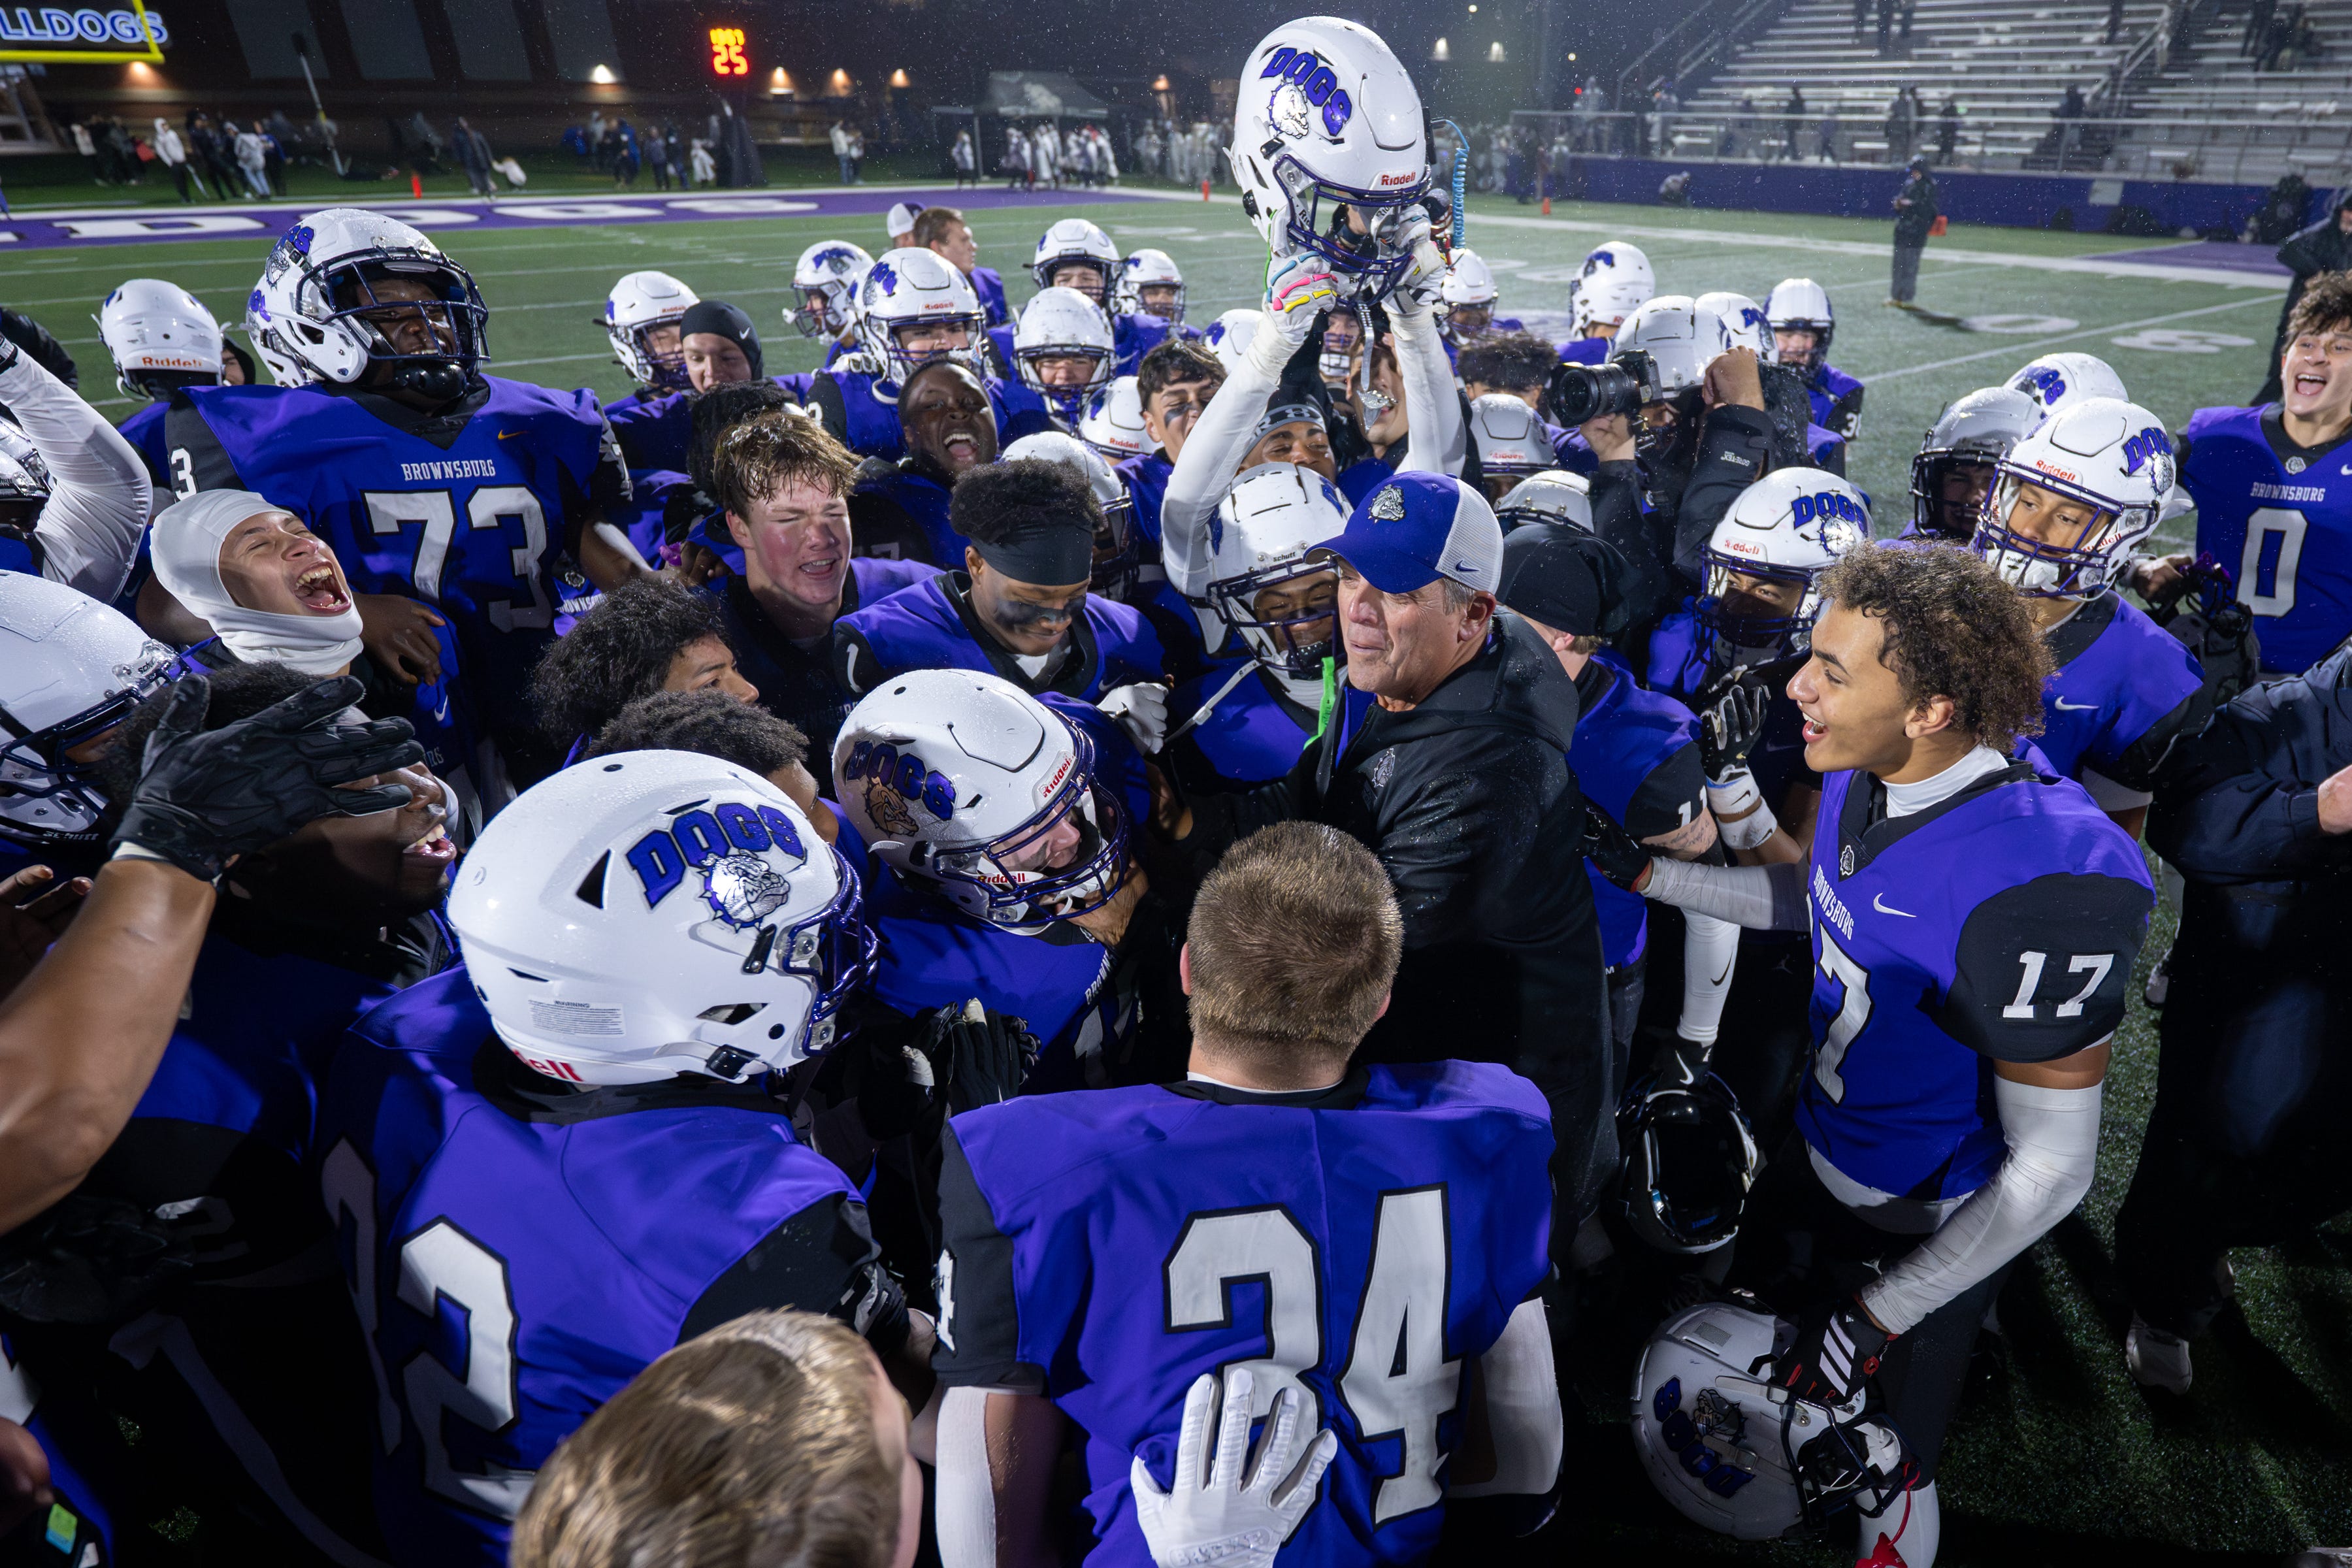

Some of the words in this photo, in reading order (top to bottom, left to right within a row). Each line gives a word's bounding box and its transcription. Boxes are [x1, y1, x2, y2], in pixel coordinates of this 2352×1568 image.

[712, 45, 748, 74] 25
[1259, 47, 1352, 137] DOGS
[1380, 172, 1416, 186] Riddell
[142, 356, 203, 367] Riddell
[400, 459, 496, 482] BROWNSBURG
[1109, 438, 1139, 449] Riddell
[2035, 459, 2076, 482] Riddell
[167, 448, 197, 502] 3
[2250, 482, 2326, 502] BROWNSBURG
[364, 486, 553, 633] 73
[1273, 551, 1296, 563] schutt
[2236, 507, 2308, 617] 0
[845, 740, 957, 822] DOGS
[625, 802, 808, 910] DOGS
[1813, 864, 1855, 941] BROWNSBURG
[1806, 892, 1872, 1105] 7
[2002, 951, 2114, 1019] 17
[1169, 1189, 1463, 1544] 34
